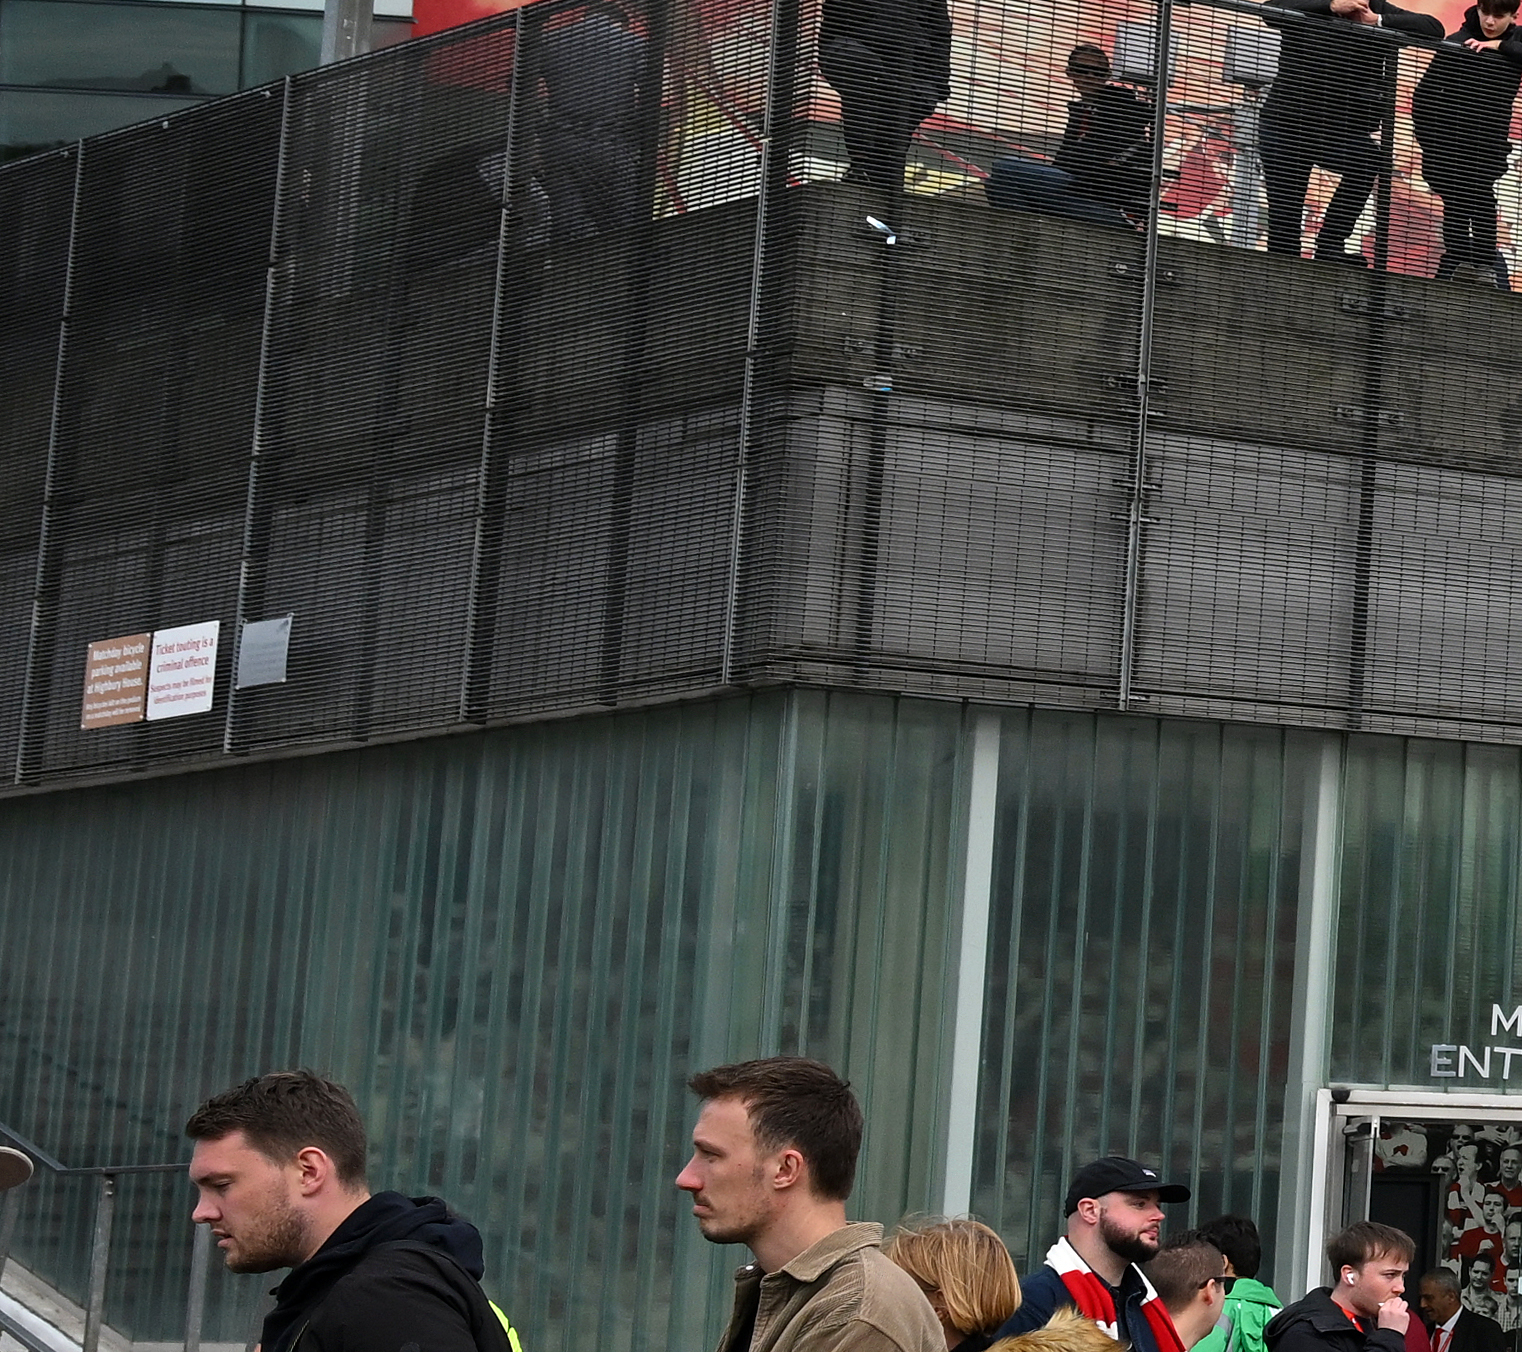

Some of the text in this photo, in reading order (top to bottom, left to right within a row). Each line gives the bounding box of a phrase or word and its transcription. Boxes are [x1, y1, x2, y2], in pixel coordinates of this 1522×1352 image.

[156, 641, 175, 655] Ticket
[176, 639, 201, 653] touting
[202, 638, 209, 647] is
[156, 656, 210, 673] criminal offence
